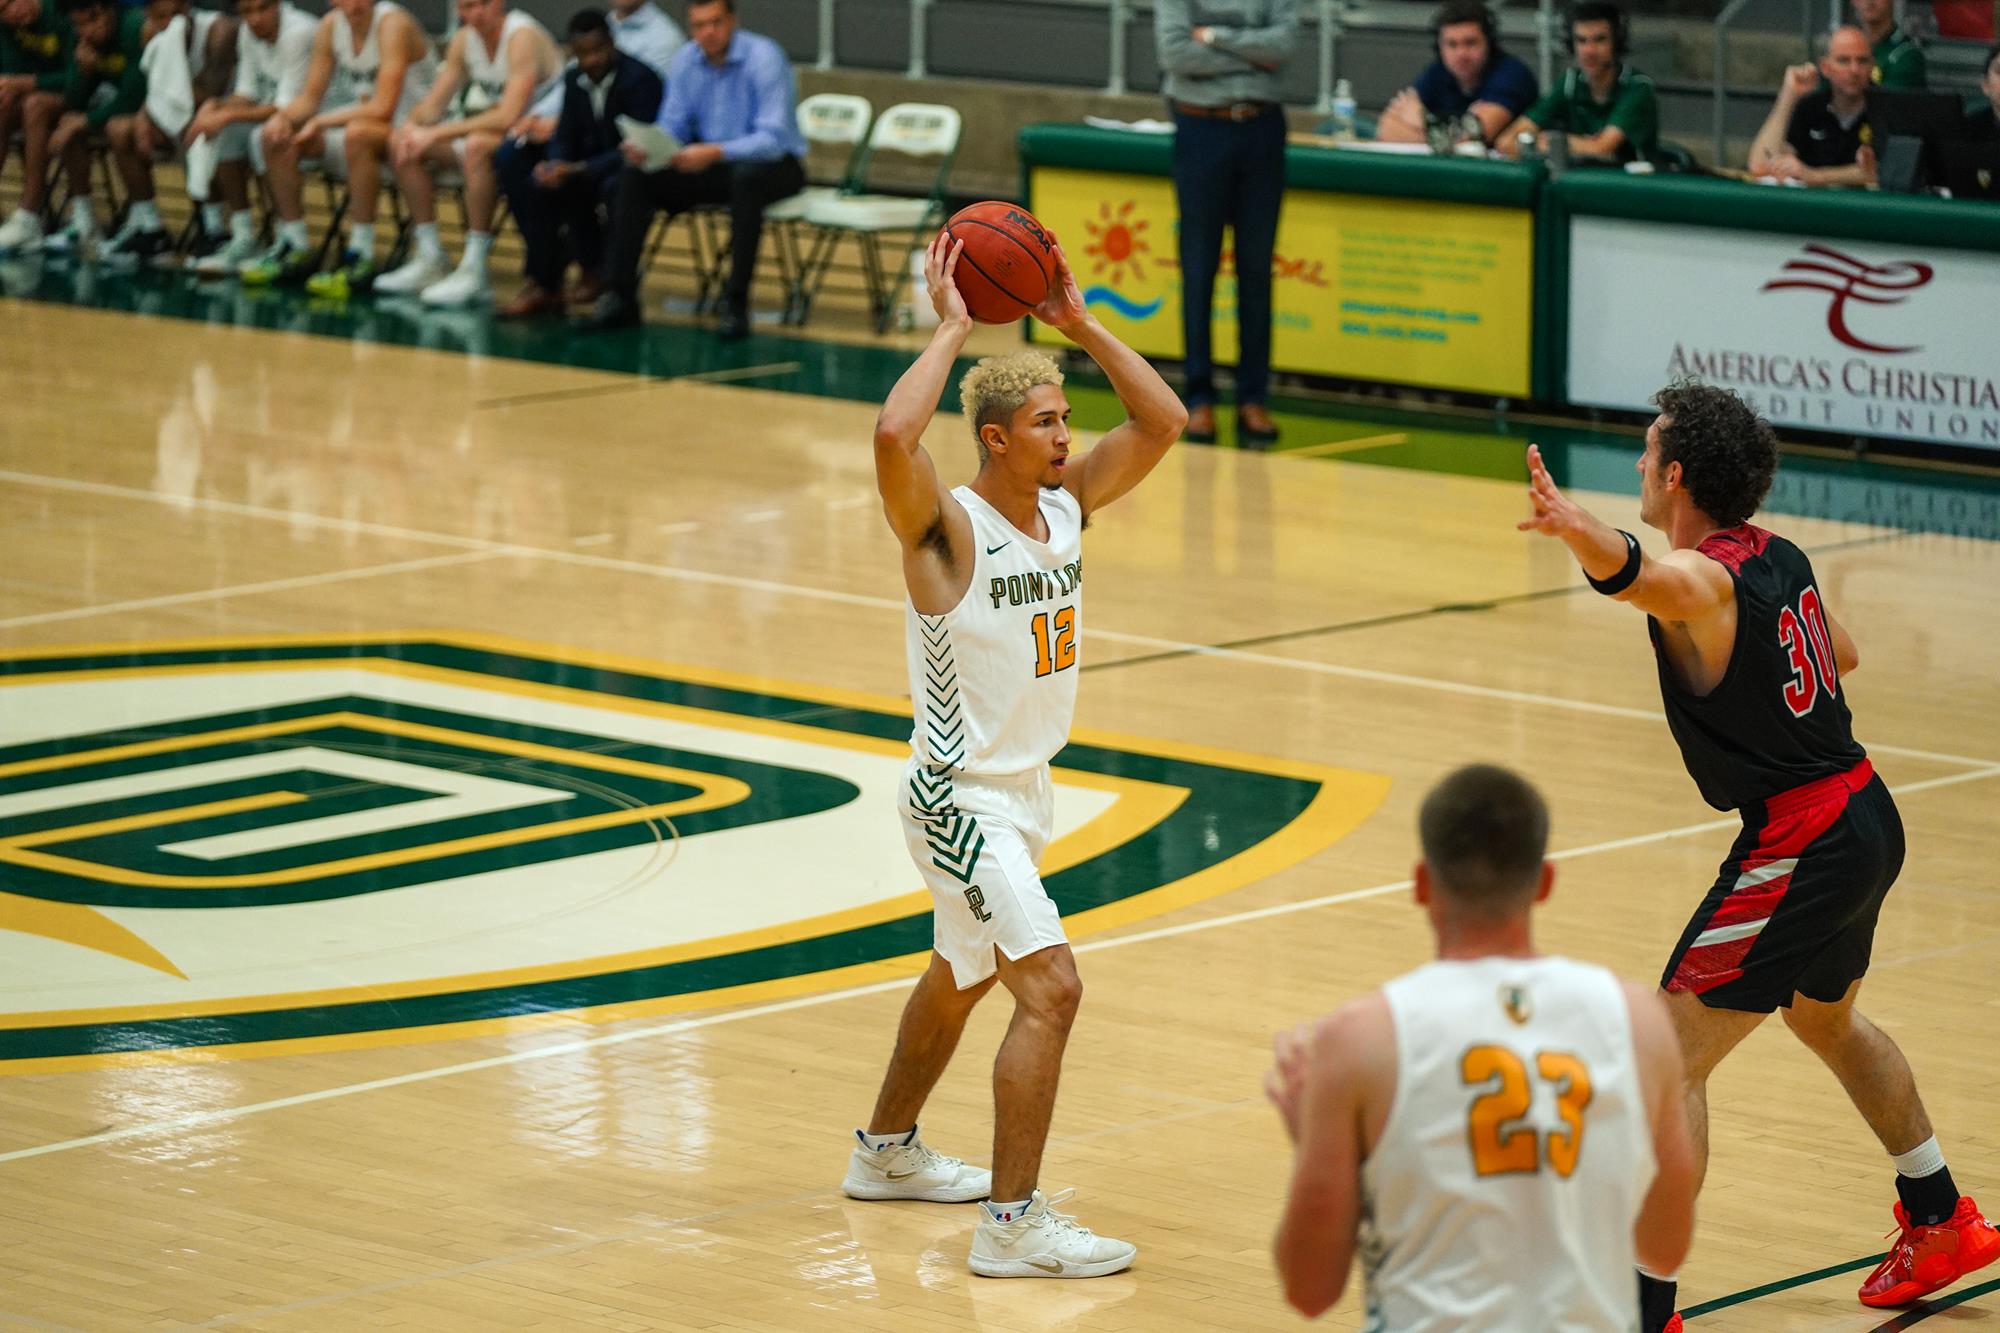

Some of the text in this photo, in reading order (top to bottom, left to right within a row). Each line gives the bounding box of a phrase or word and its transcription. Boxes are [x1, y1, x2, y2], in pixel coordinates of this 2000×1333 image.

[1005, 210, 1052, 254] NCAA
[1666, 340, 2000, 411] AMERICA'S CHRISTIA
[1866, 403, 1999, 441] UNION
[989, 571, 1054, 609] POINT
[1031, 605, 1075, 678] 12
[1778, 584, 1836, 718] 30
[1461, 1043, 1592, 1178] 23
